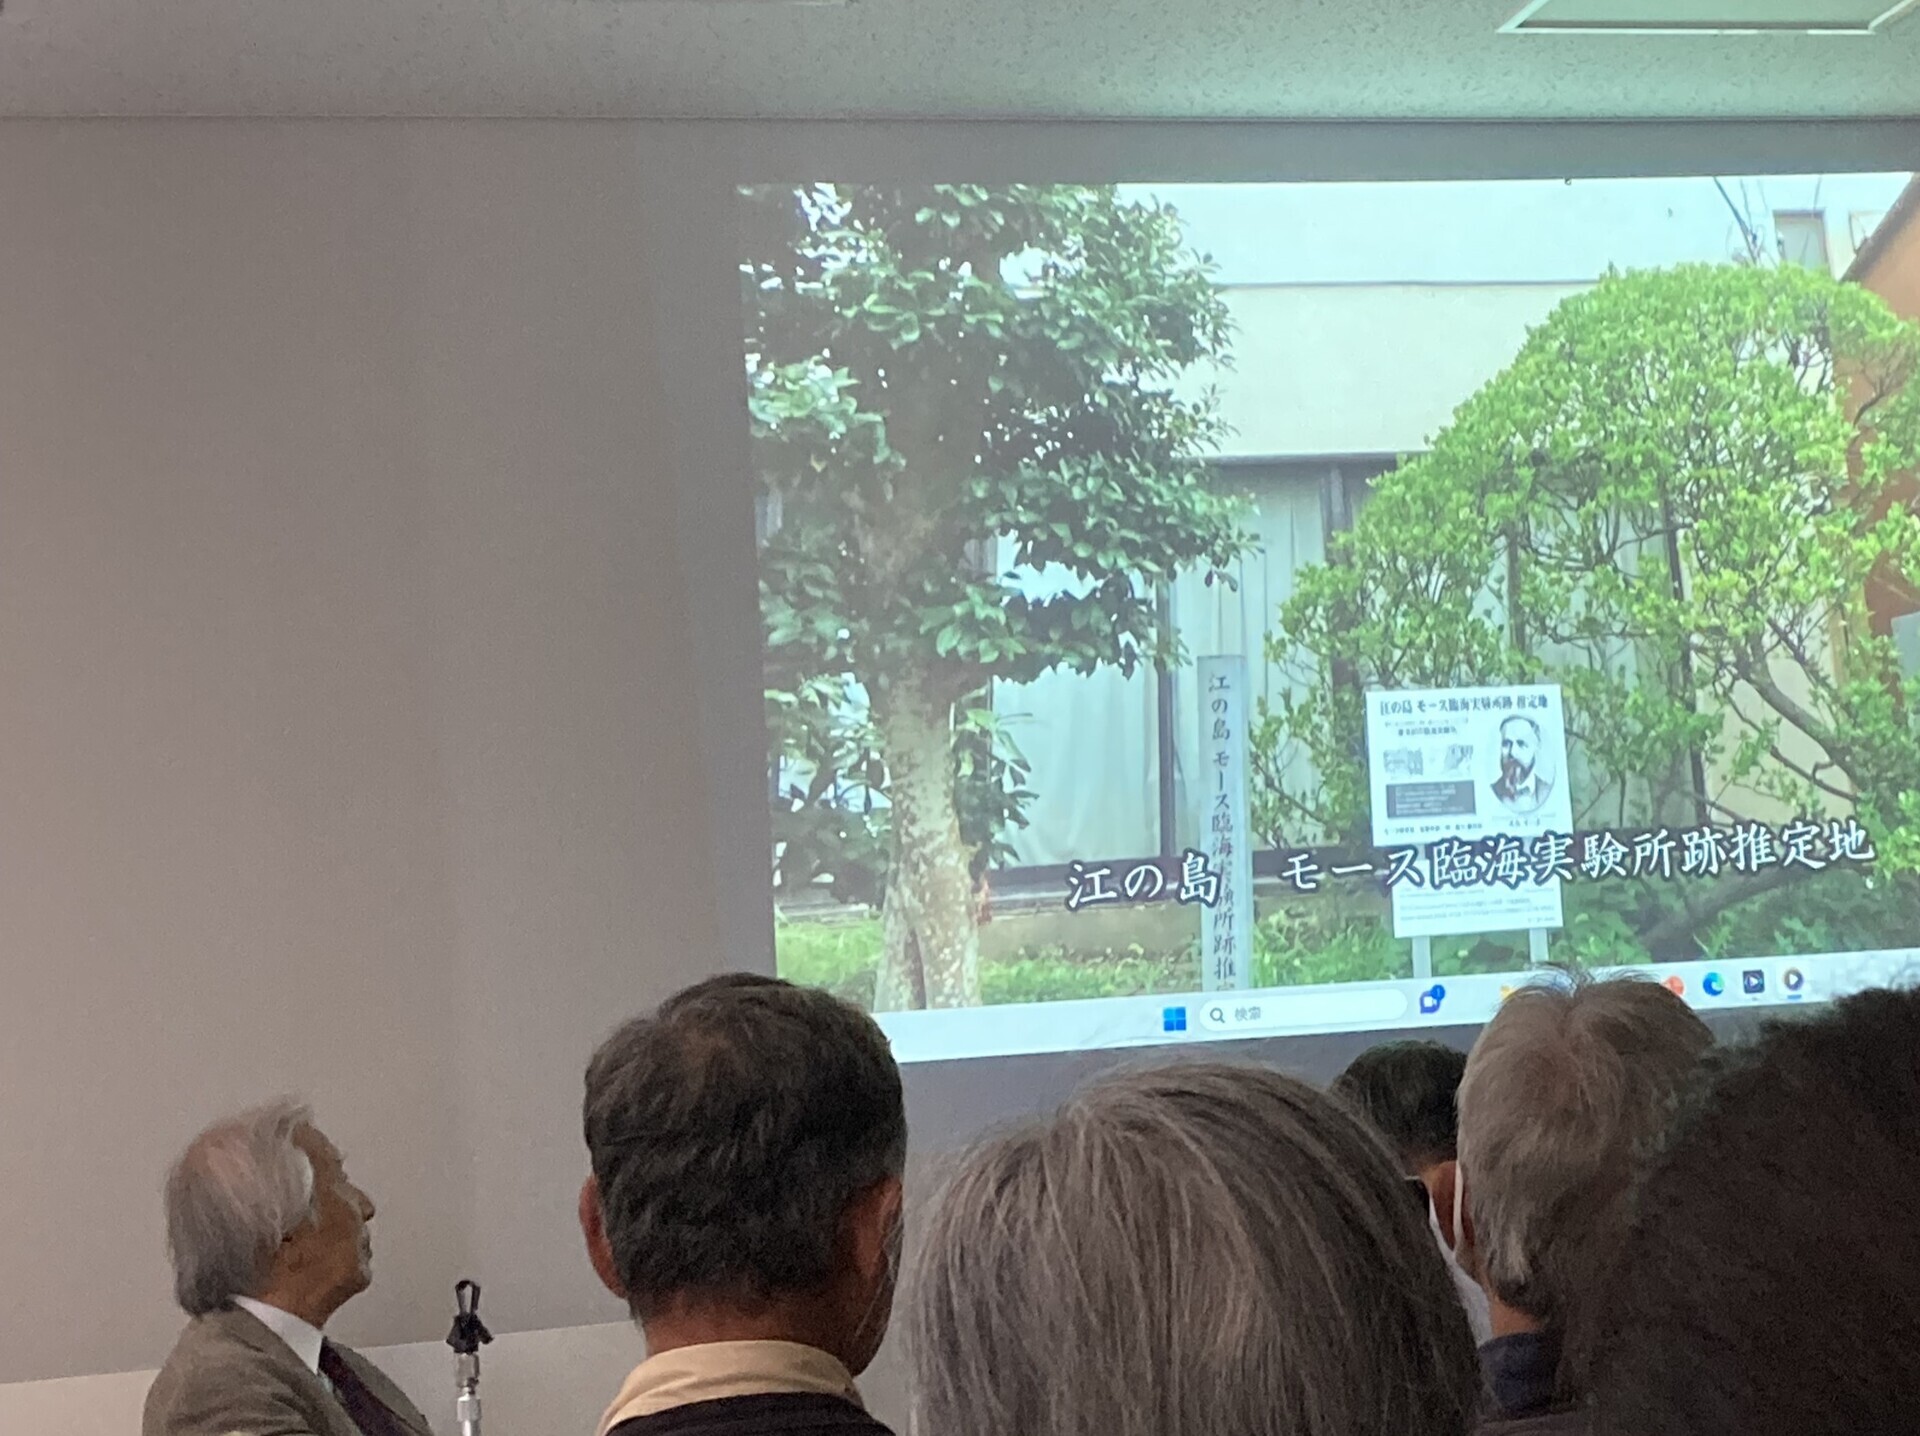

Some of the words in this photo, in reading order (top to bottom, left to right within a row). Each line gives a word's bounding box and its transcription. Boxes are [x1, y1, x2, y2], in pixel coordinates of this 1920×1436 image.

[1208, 673, 1231, 741] 江の島
[1069, 852, 1220, 909] 江の島
[1282, 819, 1876, 891] モース臨海実験所跡推定地
